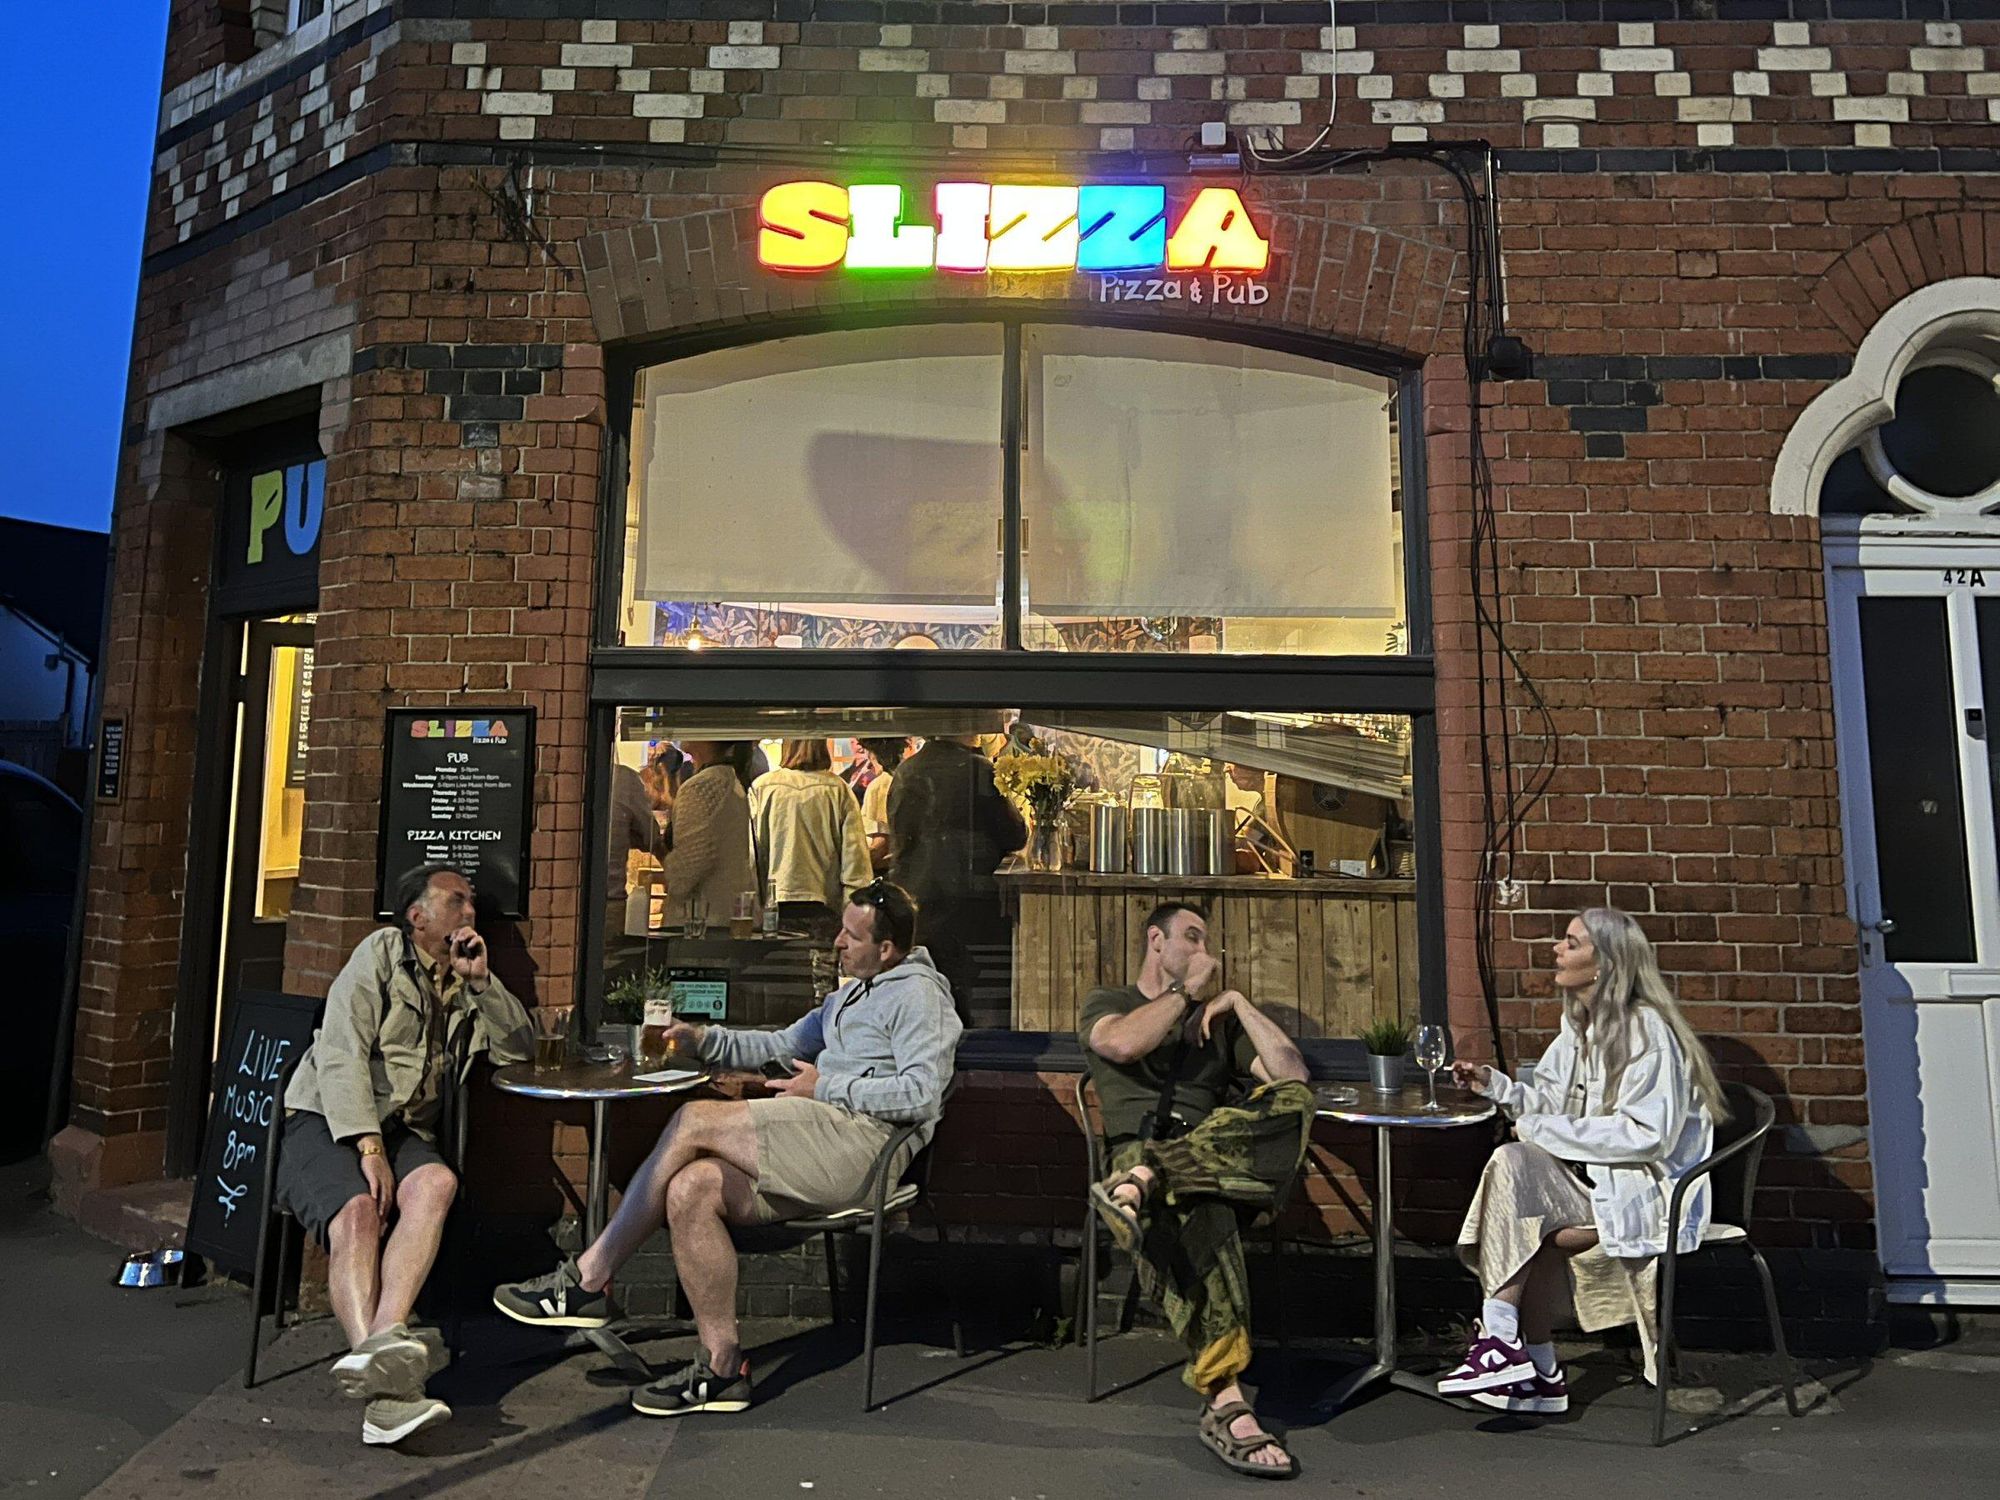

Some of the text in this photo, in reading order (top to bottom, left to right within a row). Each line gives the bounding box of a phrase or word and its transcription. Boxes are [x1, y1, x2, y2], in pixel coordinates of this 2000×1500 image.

[758, 181, 1270, 274] SLIZZA
[1099, 274, 1270, 305] Pizza & Pub
[1944, 569, 1986, 587] 42A
[411, 720, 508, 738] SLIZZA
[447, 752, 469, 763] PUB
[407, 830, 502, 840] PIZZA KITCHEN
